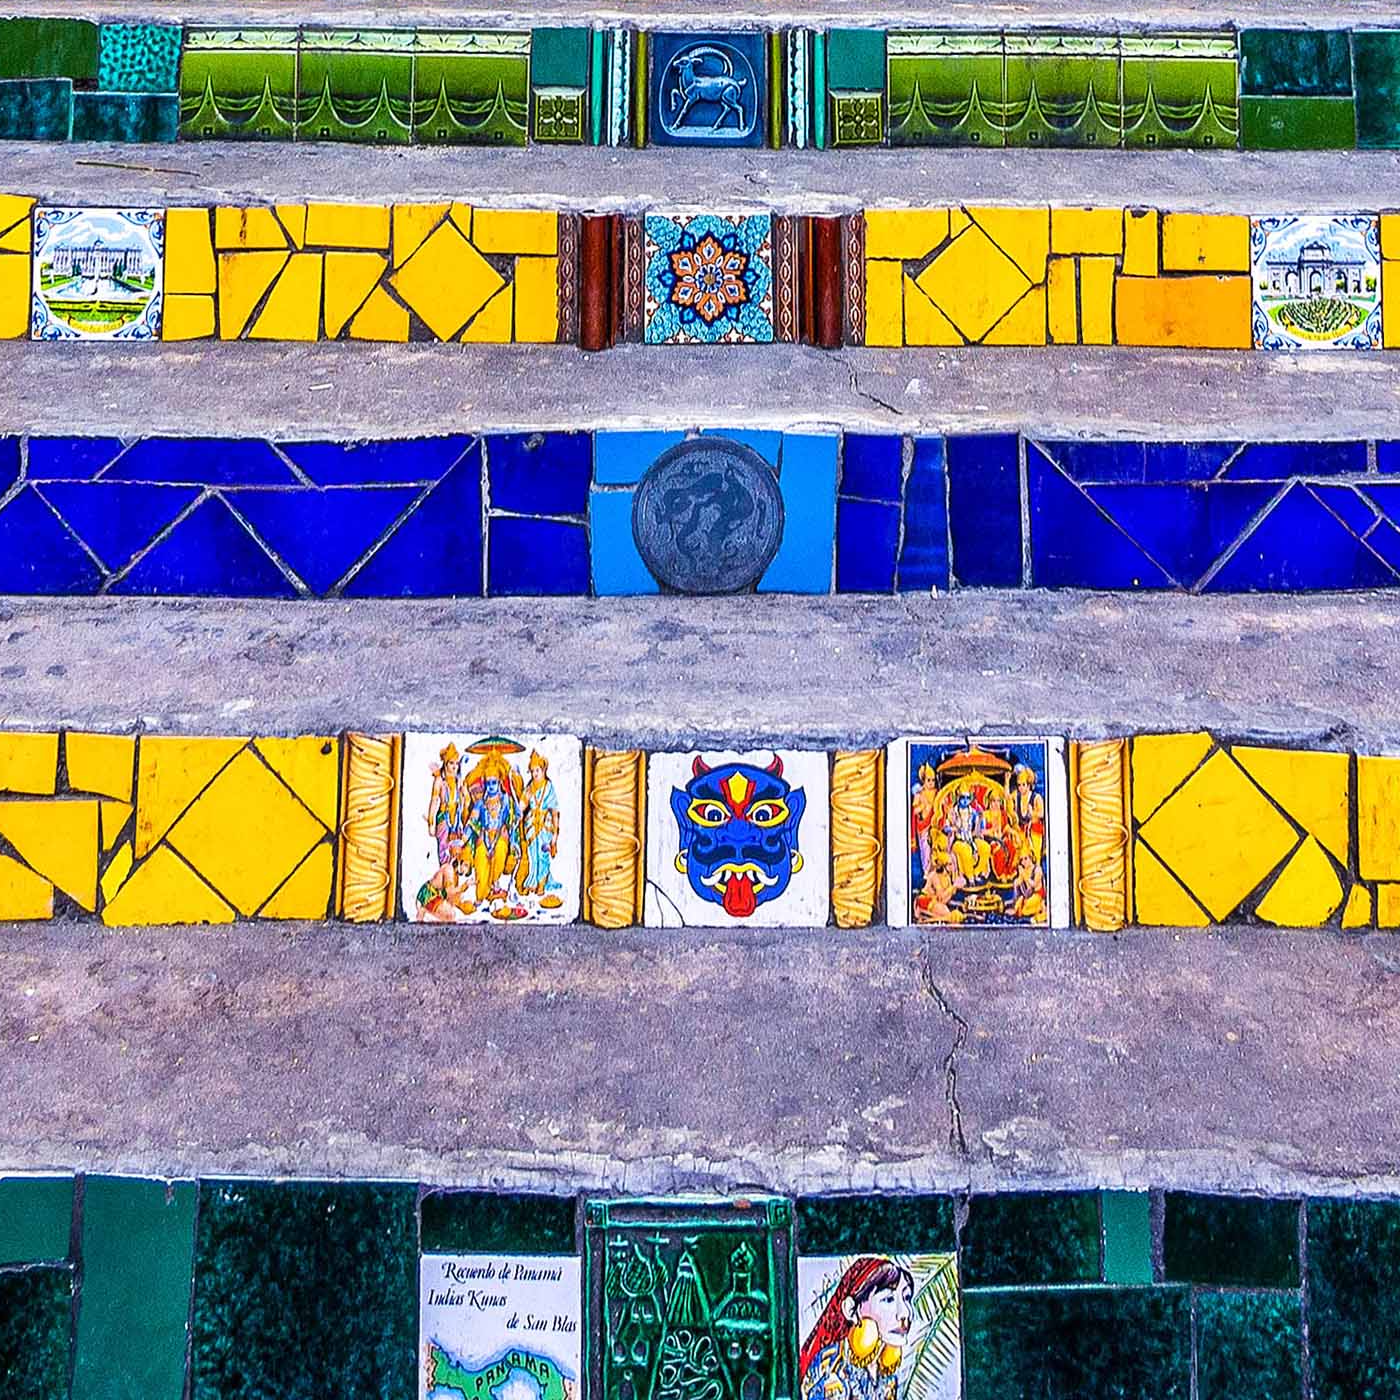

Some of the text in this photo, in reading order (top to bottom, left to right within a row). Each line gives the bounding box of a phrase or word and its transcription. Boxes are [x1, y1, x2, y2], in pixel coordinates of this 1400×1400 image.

[441, 1262, 495, 1284] Recuerdo
[499, 1262, 511, 1280] de
[428, 1288, 508, 1311] Indias Kunas
[506, 1312, 578, 1333] de San Blas
[476, 1352, 550, 1392] PANAMA
